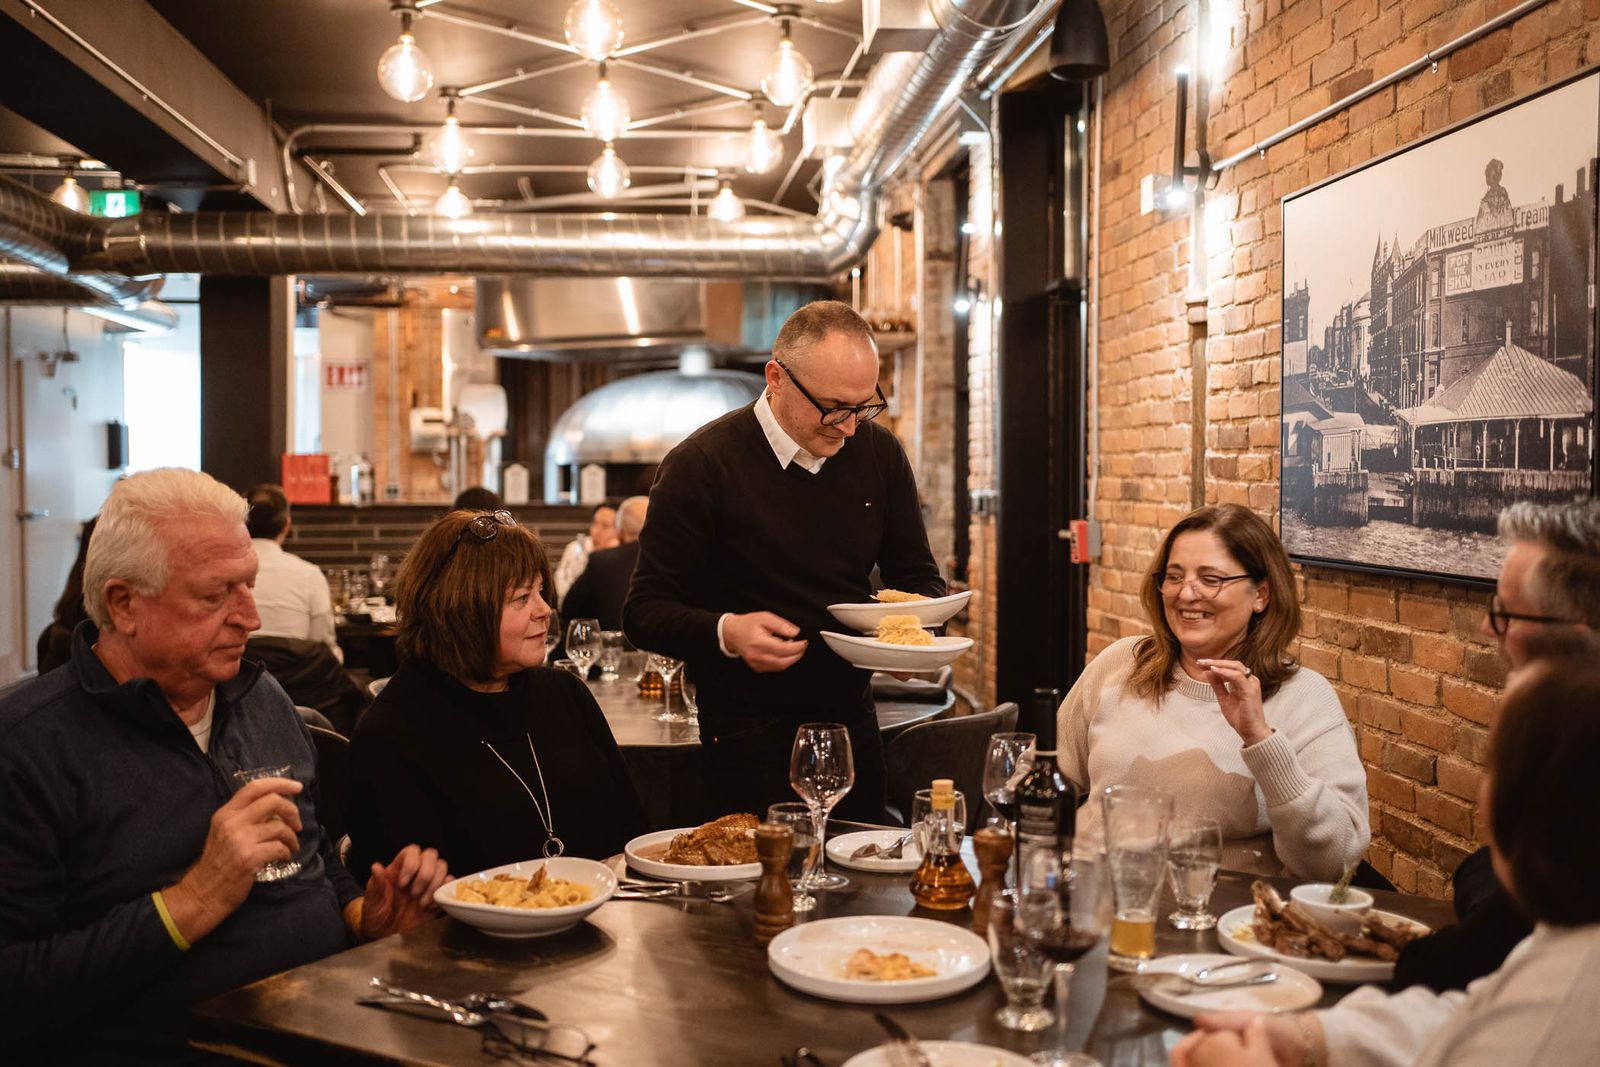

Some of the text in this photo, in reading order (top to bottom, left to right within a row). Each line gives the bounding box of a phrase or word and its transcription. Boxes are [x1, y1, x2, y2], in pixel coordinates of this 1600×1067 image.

[1428, 206, 1548, 250] Milkweed Cream
[1449, 254, 1470, 268] FOR
[1485, 259, 1509, 271] EVERY
[1454, 265, 1466, 276] THE
[1448, 273, 1471, 289] SKIN
